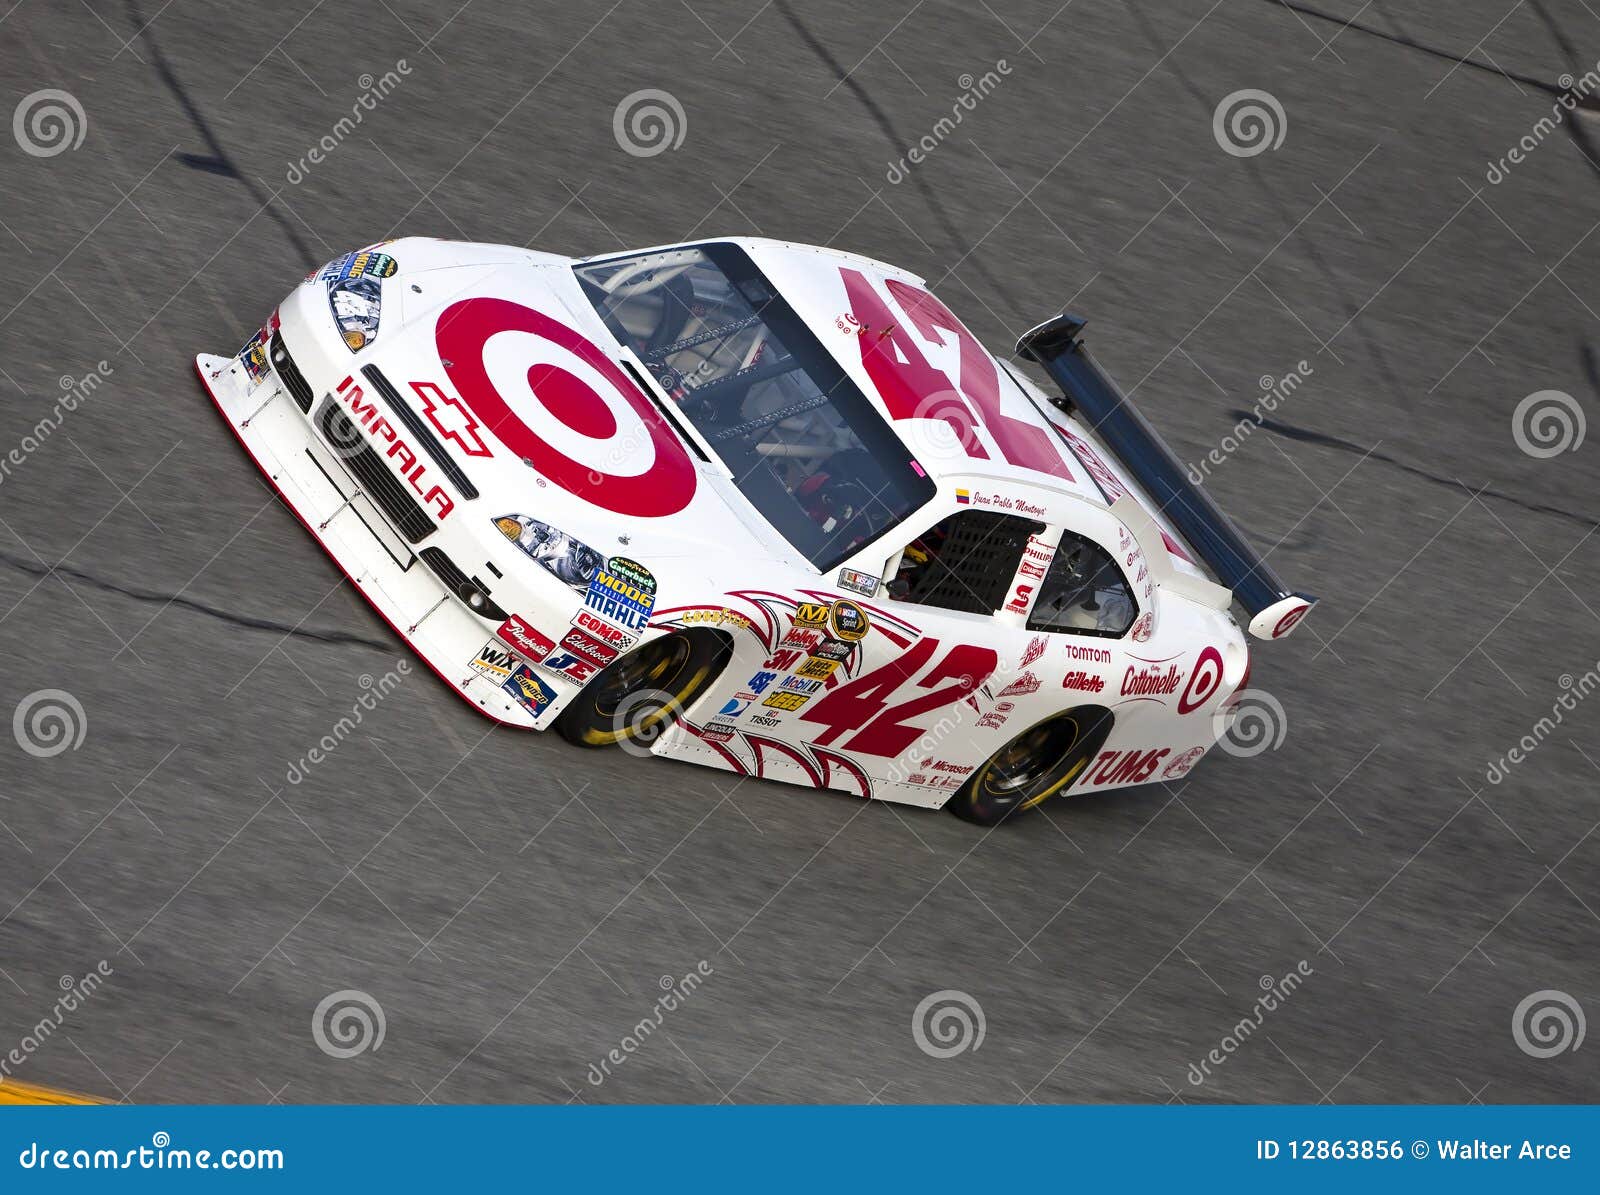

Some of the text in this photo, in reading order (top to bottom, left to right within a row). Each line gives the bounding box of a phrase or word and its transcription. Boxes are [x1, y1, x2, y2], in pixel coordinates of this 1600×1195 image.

[838, 266, 1077, 483] 42
[336, 375, 455, 521] IMPALA
[972, 491, 991, 505] Juan
[992, 495, 1013, 509] Pablo
[609, 560, 654, 587] Gatorback
[595, 571, 655, 608] MOOG
[584, 589, 649, 634] MAHLE
[577, 612, 623, 641] COMP
[481, 646, 514, 671] WIX
[565, 634, 614, 664] Edelbrock
[763, 649, 803, 671] 3M
[544, 653, 598, 681] JE
[1120, 664, 1182, 697] Cottonelle
[514, 673, 548, 704] SUNOCO
[780, 675, 811, 690] Mobil
[1062, 671, 1106, 693] Gillette
[798, 637, 998, 759] 42
[750, 715, 782, 728] TISSOT
[931, 760, 974, 775] Microsoft
[1080, 748, 1171, 786] TUMS
